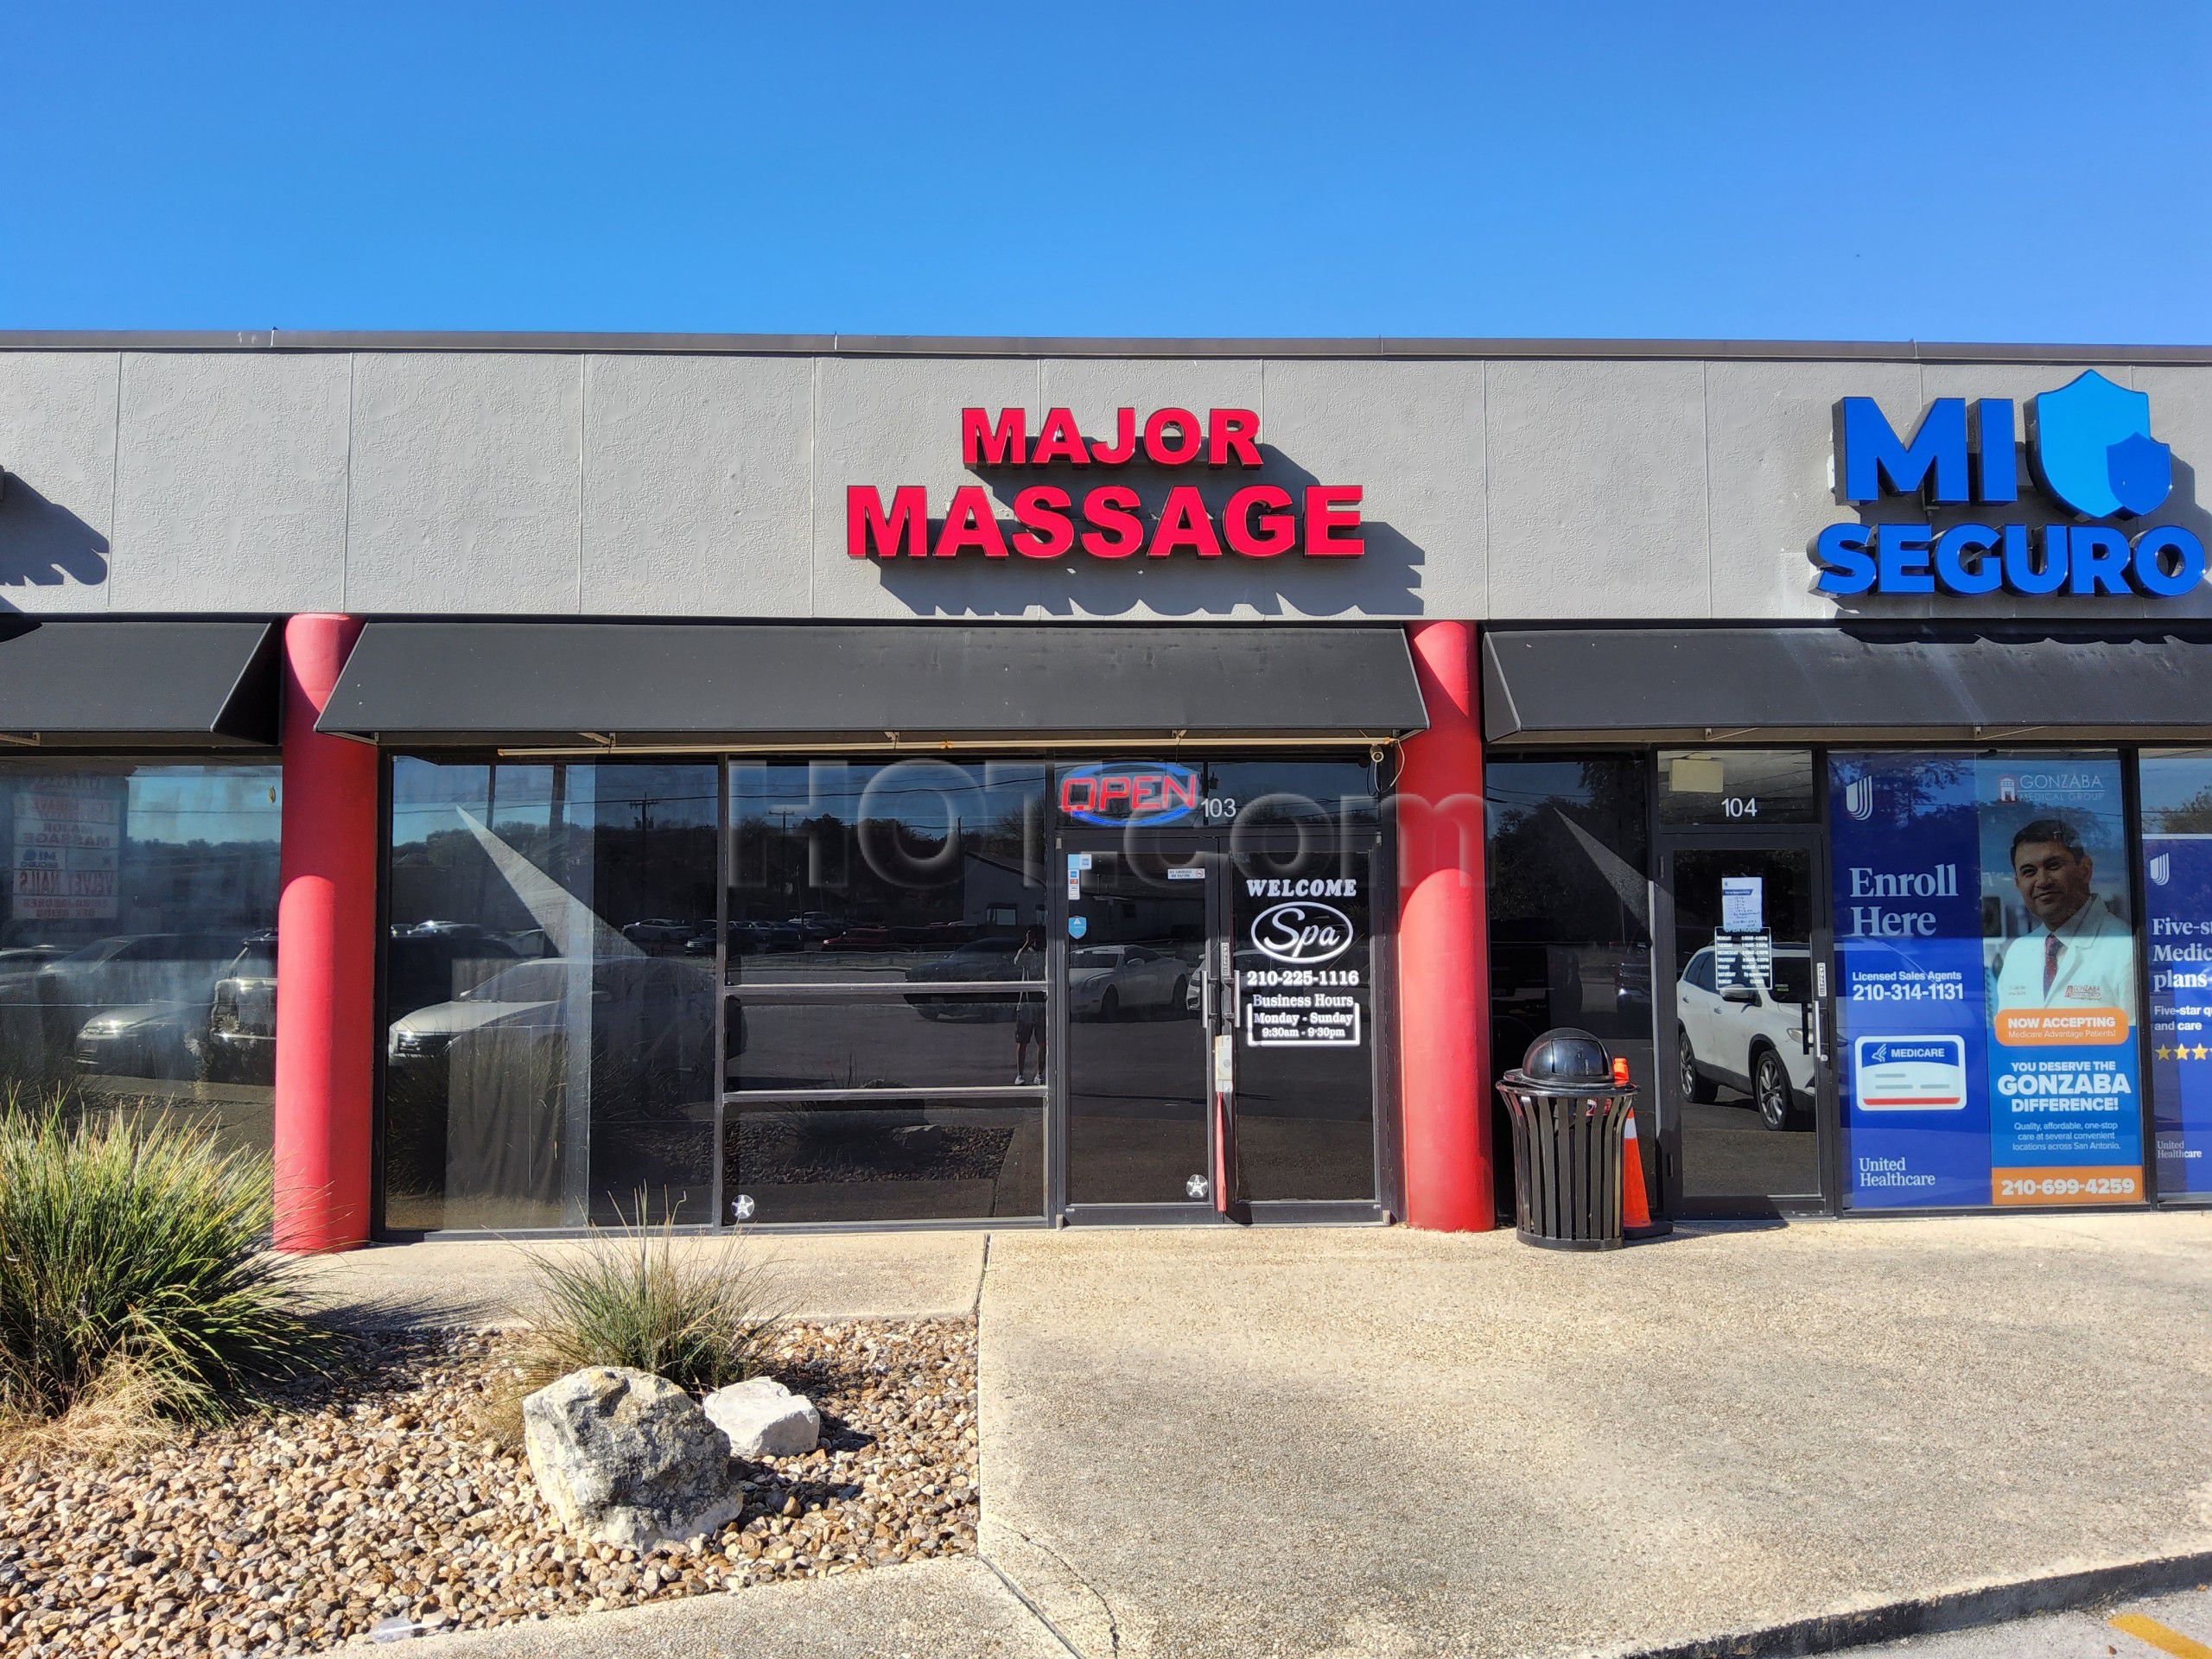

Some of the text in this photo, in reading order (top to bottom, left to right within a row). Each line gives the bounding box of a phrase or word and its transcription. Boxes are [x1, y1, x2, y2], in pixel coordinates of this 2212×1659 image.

[962, 407, 1263, 468] MAJOR
[1835, 396, 2018, 506] MI
[847, 485, 1365, 558] MASSAGE
[1813, 523, 2206, 598] SEGURO
[2019, 774, 2103, 789] GONZABA
[1060, 773, 1197, 813] OPEN
[2020, 792, 2105, 802] MEDICAL GROUP
[1200, 798, 1237, 817] 103
[1720, 797, 1758, 817] 104
[1246, 879, 1357, 897] WELCOME
[1848, 864, 1959, 897] Enroll
[1851, 906, 1937, 936] Here
[2152, 917, 2212, 936] Five-s
[1263, 907, 1341, 958] Spa
[1247, 969, 1360, 987] 210-225-1116
[1853, 970, 1962, 982] Licensed Sales Agents
[2153, 969, 2209, 993] plans
[1853, 982, 1964, 1001] 210-314-1131
[1253, 994, 1354, 1007] Business Hours
[2154, 1005, 2202, 1016] Five-star
[1254, 1012, 1300, 1027] Monday
[1310, 1012, 1354, 1027] Sunday
[2008, 1016, 2116, 1028] NOW ACCEPTING
[2154, 1020, 2202, 1031] and care
[1262, 1027, 1299, 1038] 9:30am
[2008, 1028, 2116, 1039] Medicare Advantage Patients!
[1891, 1047, 1945, 1058] MEDICARE
[2012, 1061, 2116, 1072] YOU DESERVE THE
[1997, 1073, 2132, 1096] GONZABA
[2011, 1097, 2120, 1113] DIFFERENCE!
[2013, 1122, 2119, 1132] Quality, affordable, one-stop
[2044, 1132, 2073, 1141] several
[2074, 1131, 2116, 1140] convenient
[2012, 1141, 2047, 1151] locations
[2073, 1141, 2088, 1150] San
[2089, 1141, 2121, 1150] Antonio.
[2158, 1140, 2185, 1150] United
[2158, 1149, 2203, 1159] Healthcare
[1859, 1156, 1907, 1172] United
[1859, 1172, 1936, 1187] Healthcare
[2000, 1177, 2135, 1196] 210-699-4259
